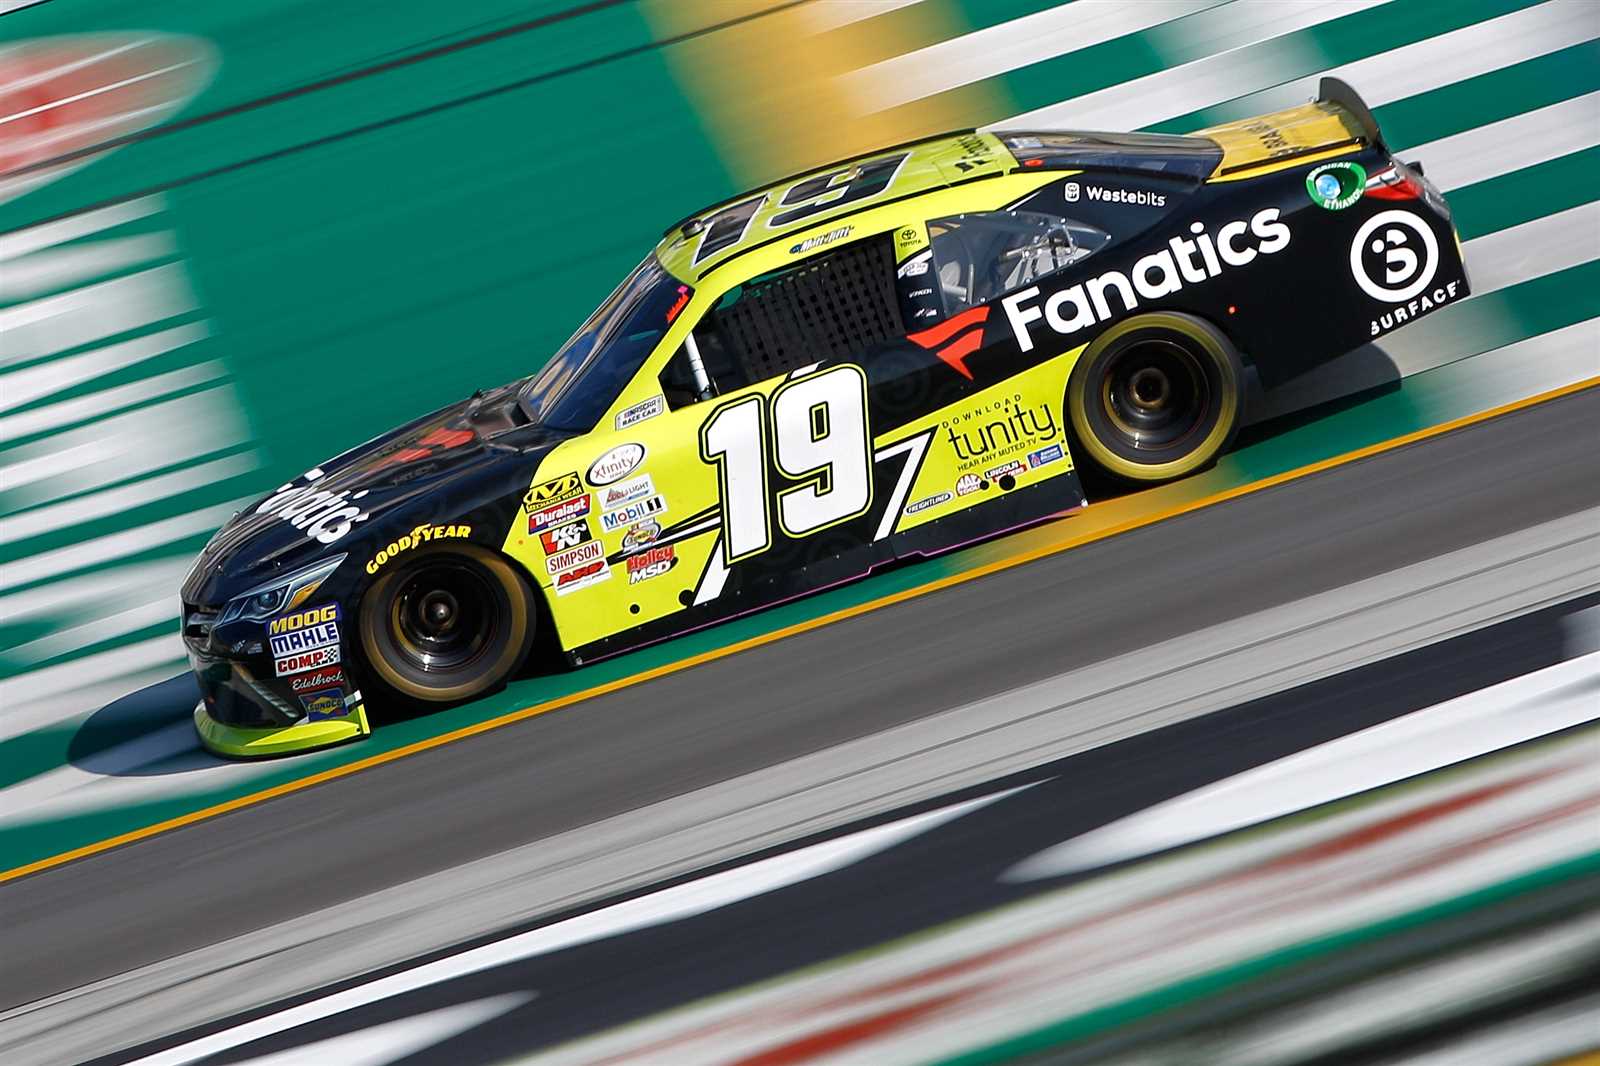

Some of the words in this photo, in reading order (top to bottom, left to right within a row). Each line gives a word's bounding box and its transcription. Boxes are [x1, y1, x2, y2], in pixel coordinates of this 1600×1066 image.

[1086, 186, 1166, 207] Wastebits
[900, 239, 921, 249] TOYOTA
[1002, 207, 1291, 353] Fanatics
[1371, 281, 1457, 336] SURFACE
[642, 407, 657, 417] CAR
[942, 394, 1022, 430] DOWNLOAD
[948, 403, 1057, 460] tunity
[594, 457, 634, 479] xfinity
[698, 363, 873, 566] 19
[957, 459, 980, 472] HEAR
[981, 454, 998, 464] ANY
[999, 443, 1026, 458] MUTED
[1027, 437, 1037, 446] TV
[985, 461, 1020, 479] LINCOLN
[562, 486, 582, 499] WEAR
[629, 481, 649, 494] LIGHT
[531, 497, 587, 526] Duralast
[603, 503, 645, 528] Mobil
[647, 497, 662, 512] 1
[366, 523, 472, 575] GOODYEAR
[551, 523, 587, 551] K&N
[550, 543, 599, 572] SIMPSON
[628, 545, 674, 573] Holley
[630, 559, 672, 585] MSD
[269, 605, 336, 635] MOOG
[271, 624, 338, 654] MAHLE
[278, 651, 324, 672] COMP
[292, 670, 345, 690] Edelbrock
